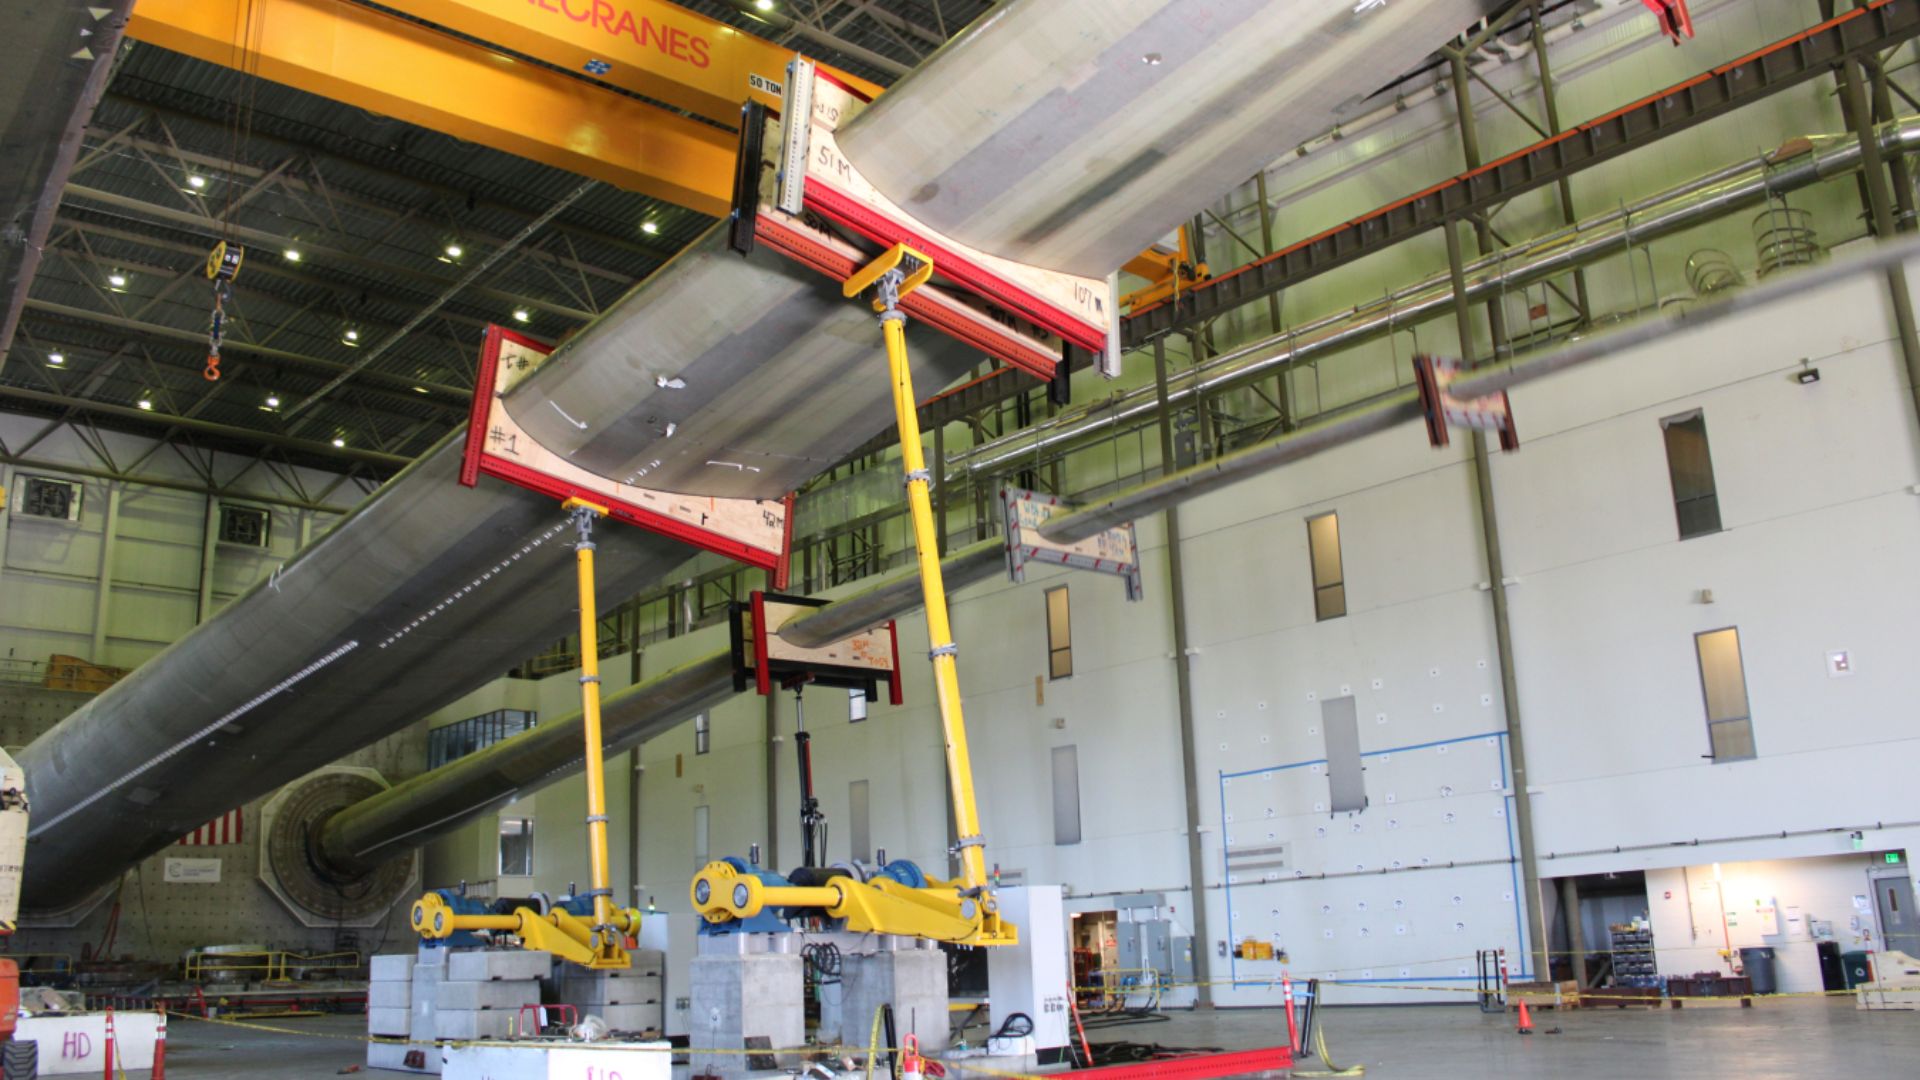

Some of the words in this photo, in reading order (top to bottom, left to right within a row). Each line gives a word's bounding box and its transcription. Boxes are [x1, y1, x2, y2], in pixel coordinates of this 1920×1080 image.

[750, 75, 762, 87] 50
[765, 80, 782, 95] TON
[489, 425, 519, 456] #1
[63, 1032, 91, 1059] HD
